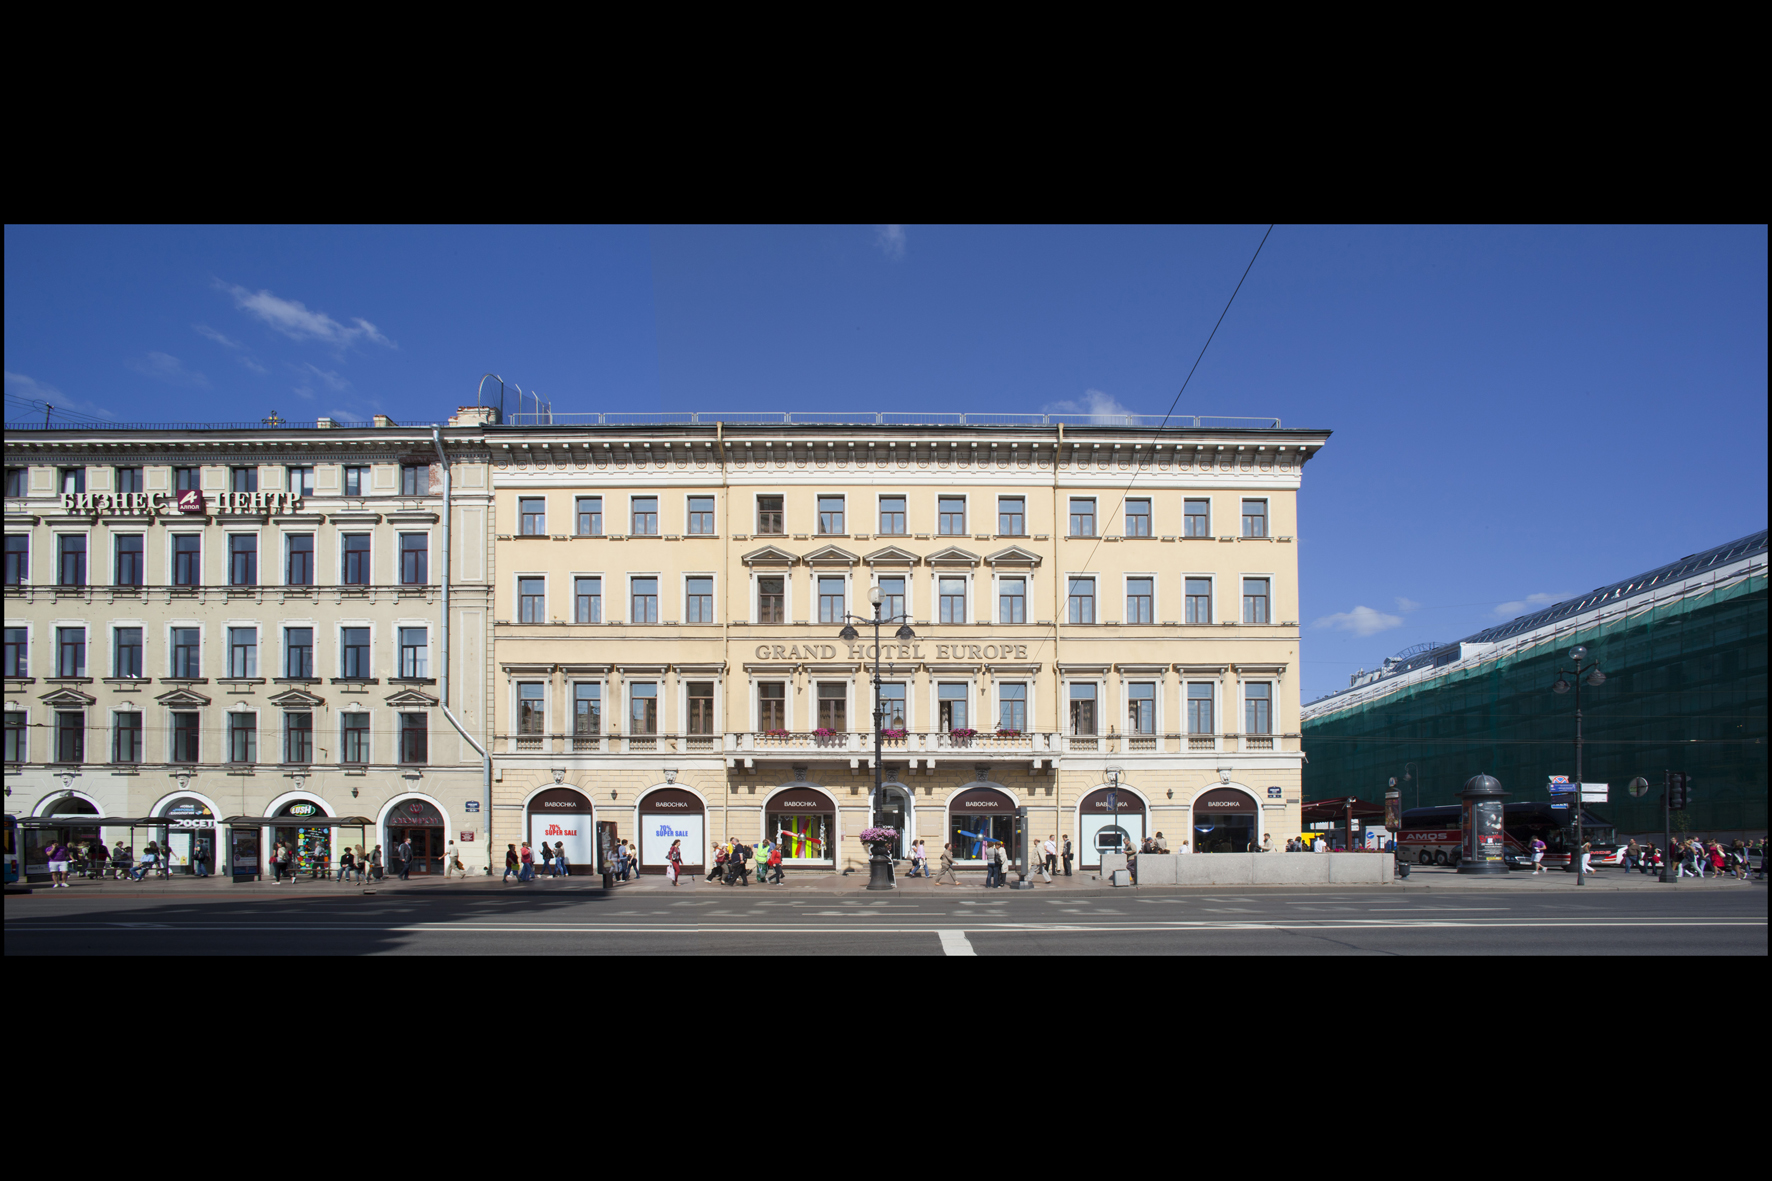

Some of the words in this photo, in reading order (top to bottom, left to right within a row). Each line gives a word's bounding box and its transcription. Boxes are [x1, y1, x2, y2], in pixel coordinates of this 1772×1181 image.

[60, 493, 170, 509] БИЗНЕС
[215, 492, 300, 512] ЦЕНТР
[755, 644, 837, 660] GRAND
[847, 644, 926, 660] HOTEL
[936, 644, 1028, 660] EUROPE
[291, 804, 312, 815] LUSH
[1406, 832, 1447, 840] AMOS
